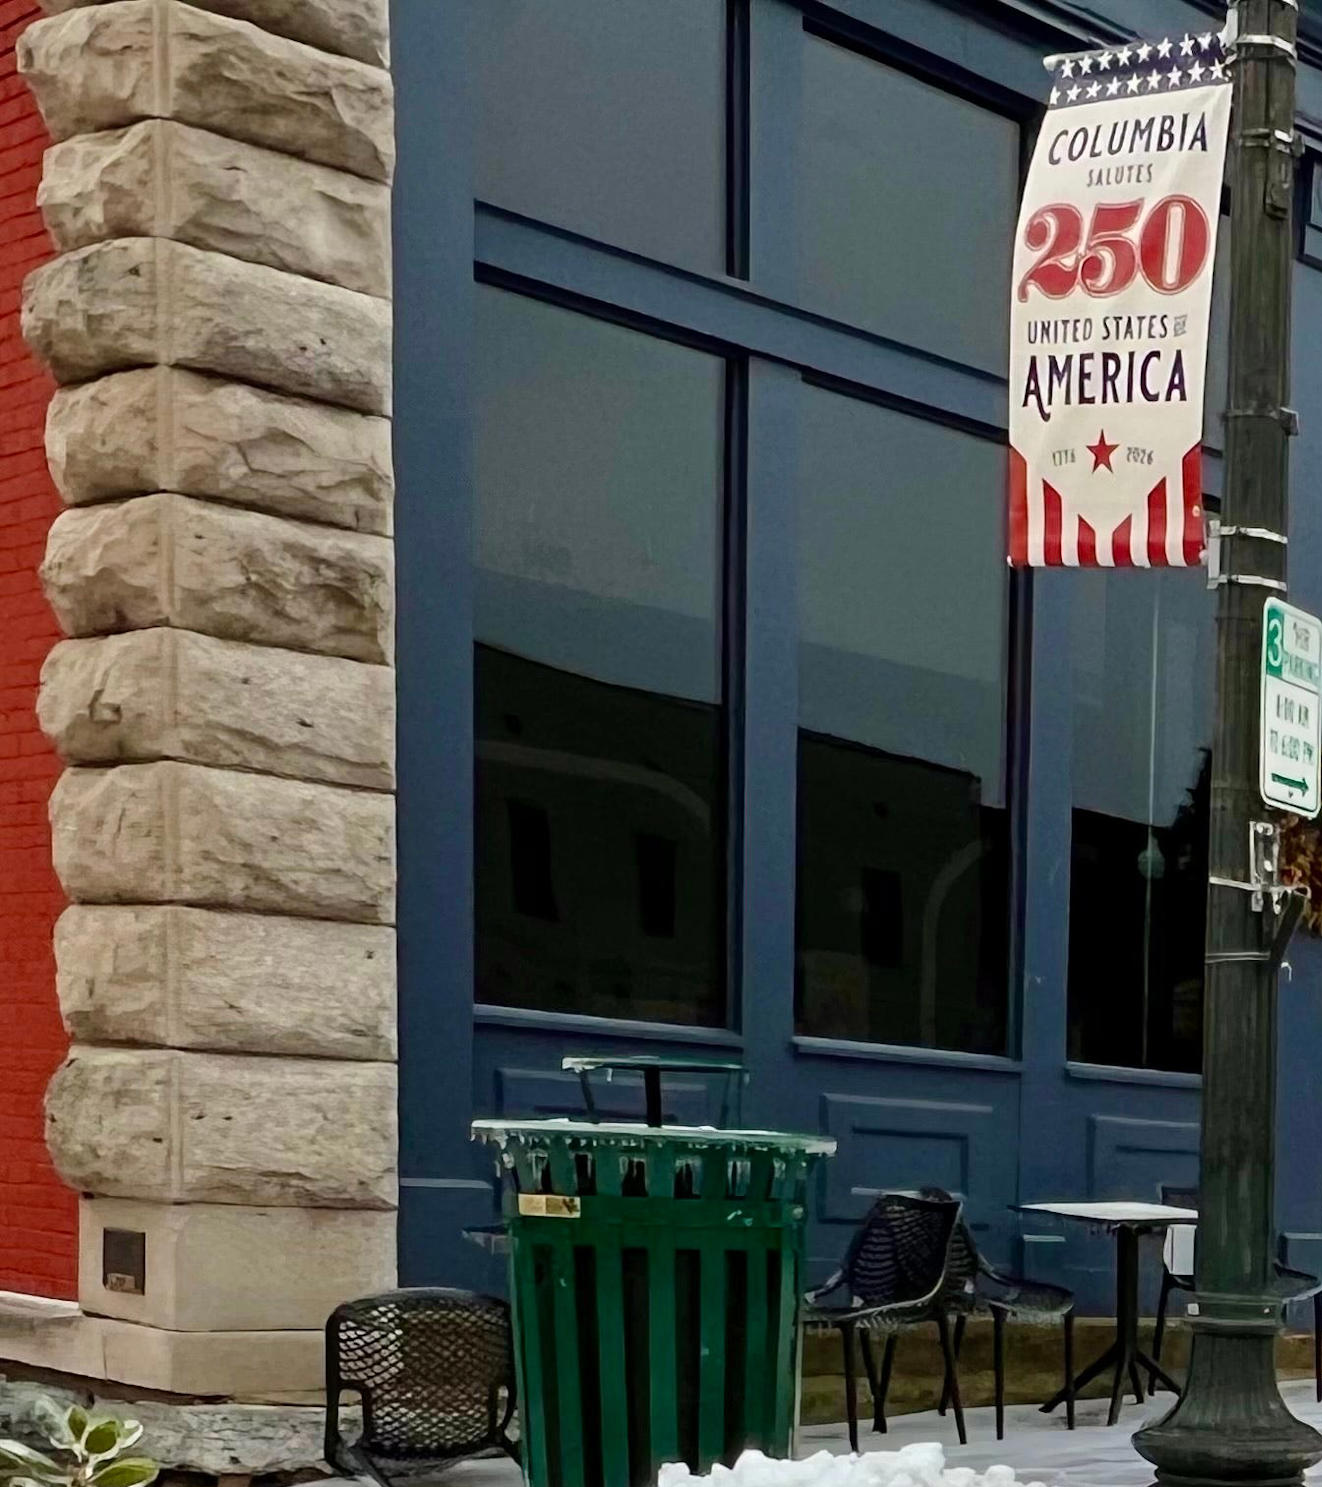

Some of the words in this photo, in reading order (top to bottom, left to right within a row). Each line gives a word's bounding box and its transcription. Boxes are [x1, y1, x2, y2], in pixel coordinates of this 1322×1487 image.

[1048, 112, 1209, 166] COLUMBIA
[1086, 163, 1153, 187] SALUTES
[1017, 194, 1211, 303] 250
[1027, 317, 1093, 345] UNITED
[1102, 314, 1169, 341] STATES
[1022, 349, 1188, 423] AMERICA
[1126, 446, 1154, 465] 2026
[1267, 617, 1283, 668] 3
